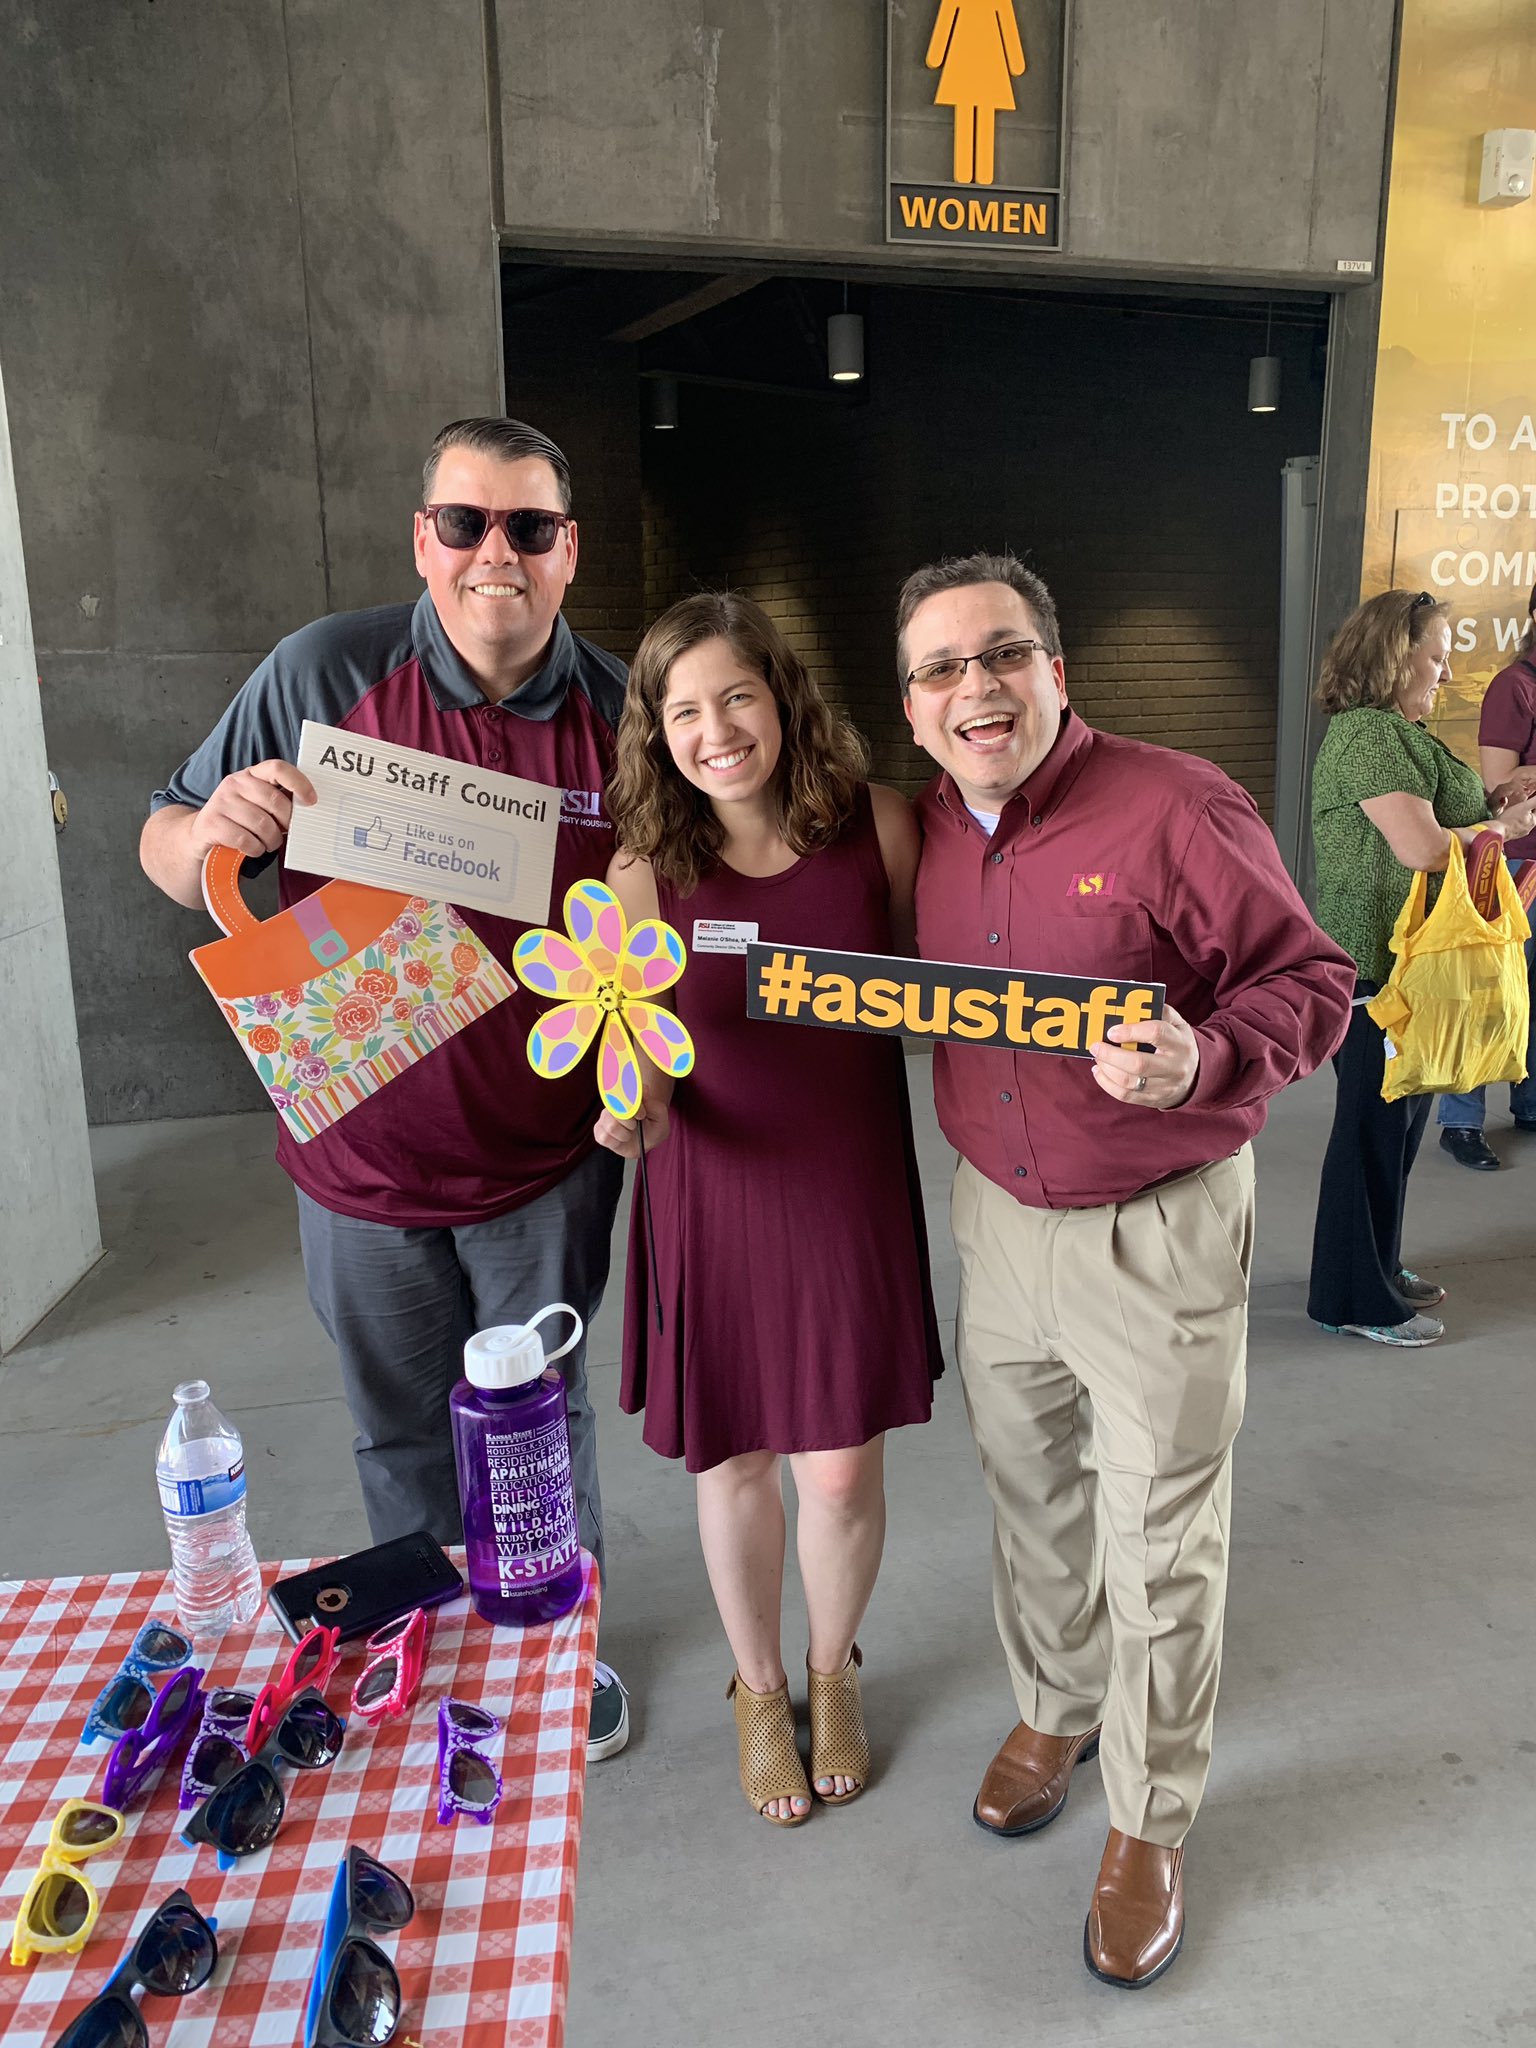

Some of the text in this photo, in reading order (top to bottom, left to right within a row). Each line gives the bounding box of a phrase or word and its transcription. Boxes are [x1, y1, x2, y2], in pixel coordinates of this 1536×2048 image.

[900, 195, 1046, 235] WOMEN
[1441, 413, 1497, 450] TO
[1436, 483, 1536, 519] PROT
[319, 745, 547, 822] ASU Staff Council
[406, 823, 475, 850] Like us on
[580, 819, 612, 829] HOUSING
[403, 841, 501, 882] Facebook
[1066, 872, 1117, 897] ASU
[758, 952, 1154, 1052] #asustaff
[486, 1429, 532, 1441] KANSAS STATE
[488, 1433, 568, 1468] RESIDENCE HALLS
[490, 1442, 569, 1480] APARTMENTS
[491, 1471, 552, 1491] EDUCATION
[491, 1465, 571, 1504] FRIENDSHIP
[493, 1498, 541, 1514] DINING
[494, 1499, 561, 1522] LEADERSHIP
[494, 1495, 574, 1534] WILDCATS
[496, 1505, 575, 1543] STUDY COMFORT
[496, 1520, 576, 1557] WELCOME
[498, 1533, 578, 1580] K-STATE
[509, 1586, 548, 1597] kstatehousing
